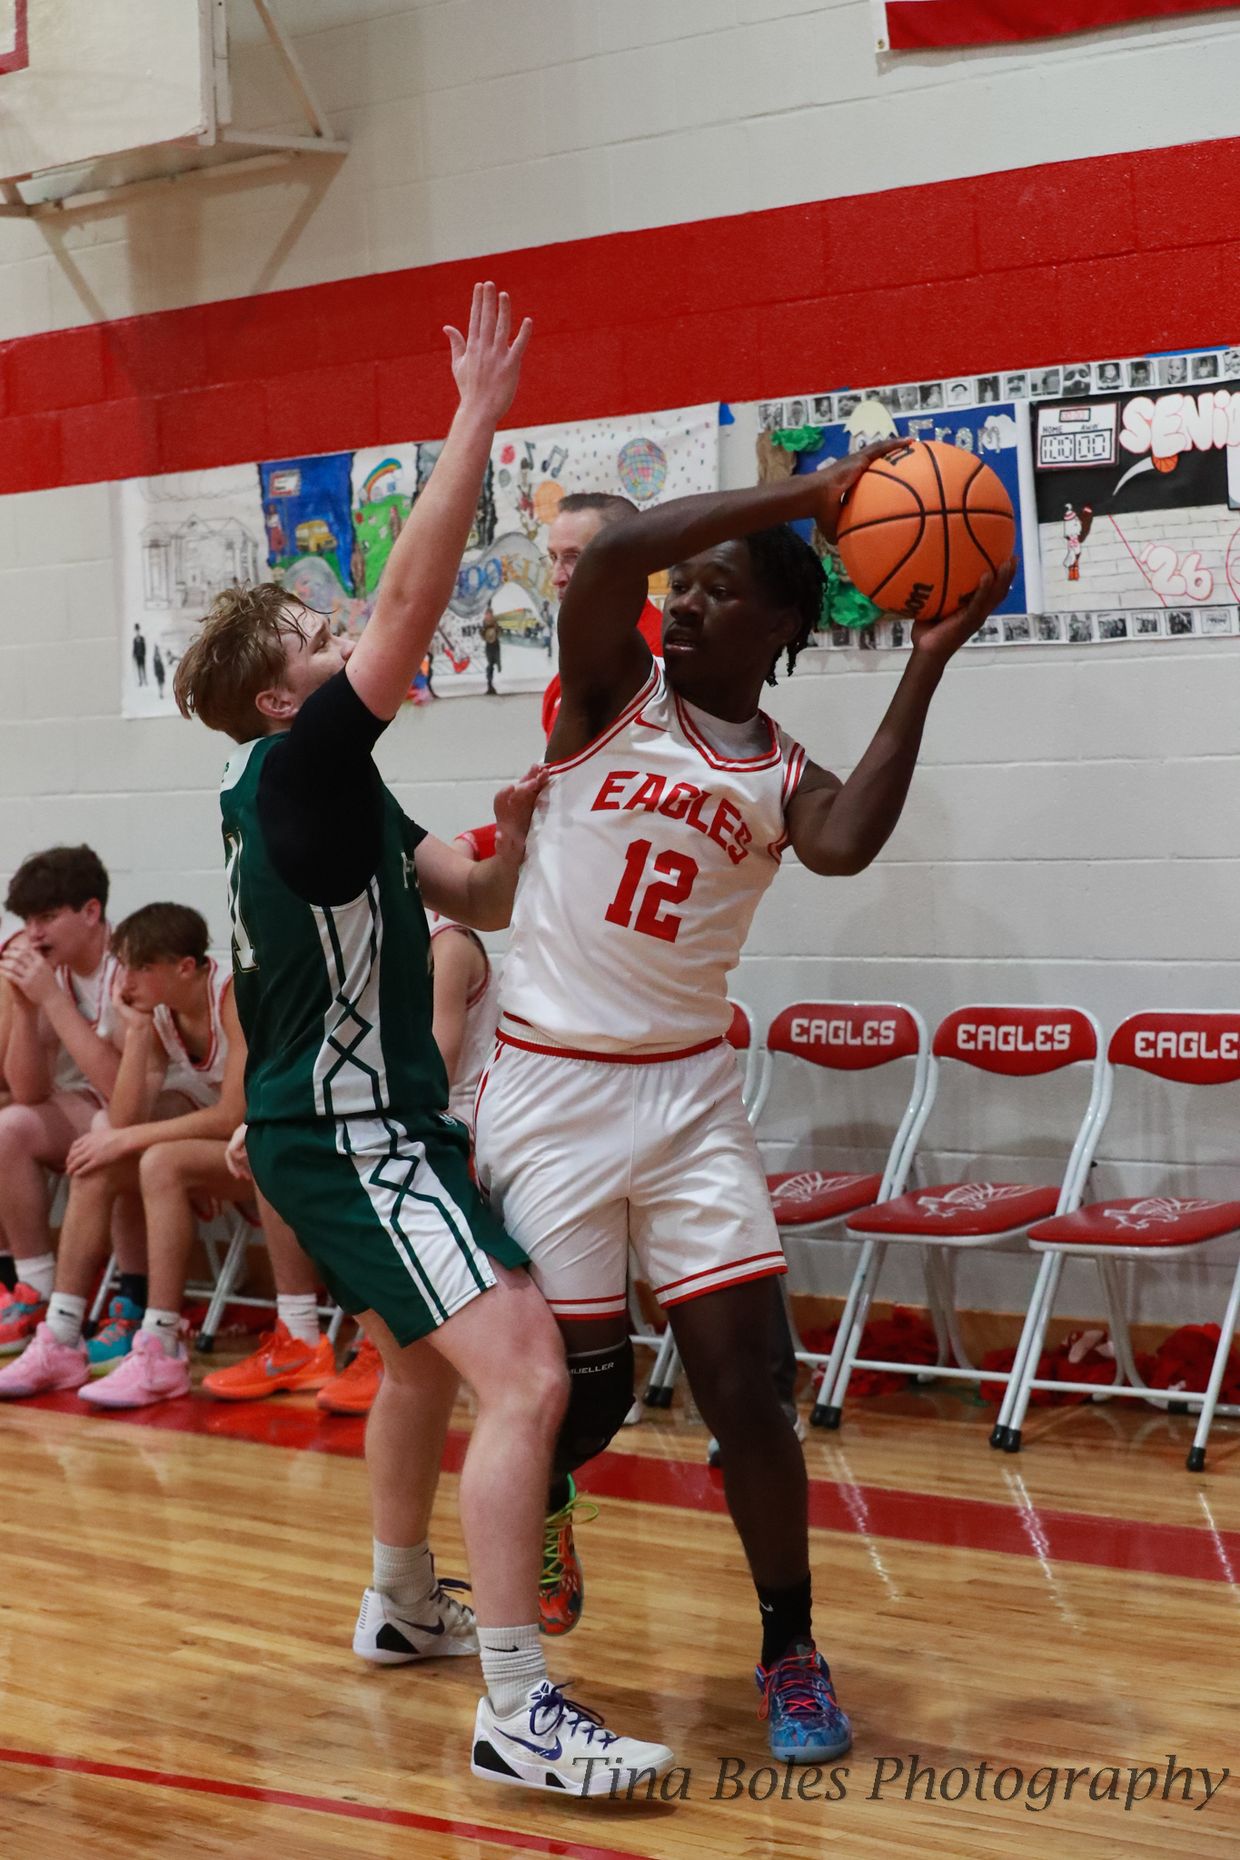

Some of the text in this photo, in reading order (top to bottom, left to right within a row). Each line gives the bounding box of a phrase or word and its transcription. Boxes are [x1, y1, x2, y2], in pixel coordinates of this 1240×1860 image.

[590, 770, 752, 864] EAGLES
[604, 838, 699, 943] 12
[790, 1018, 897, 1045] EAGLES
[957, 1023, 1072, 1052] EAGLES
